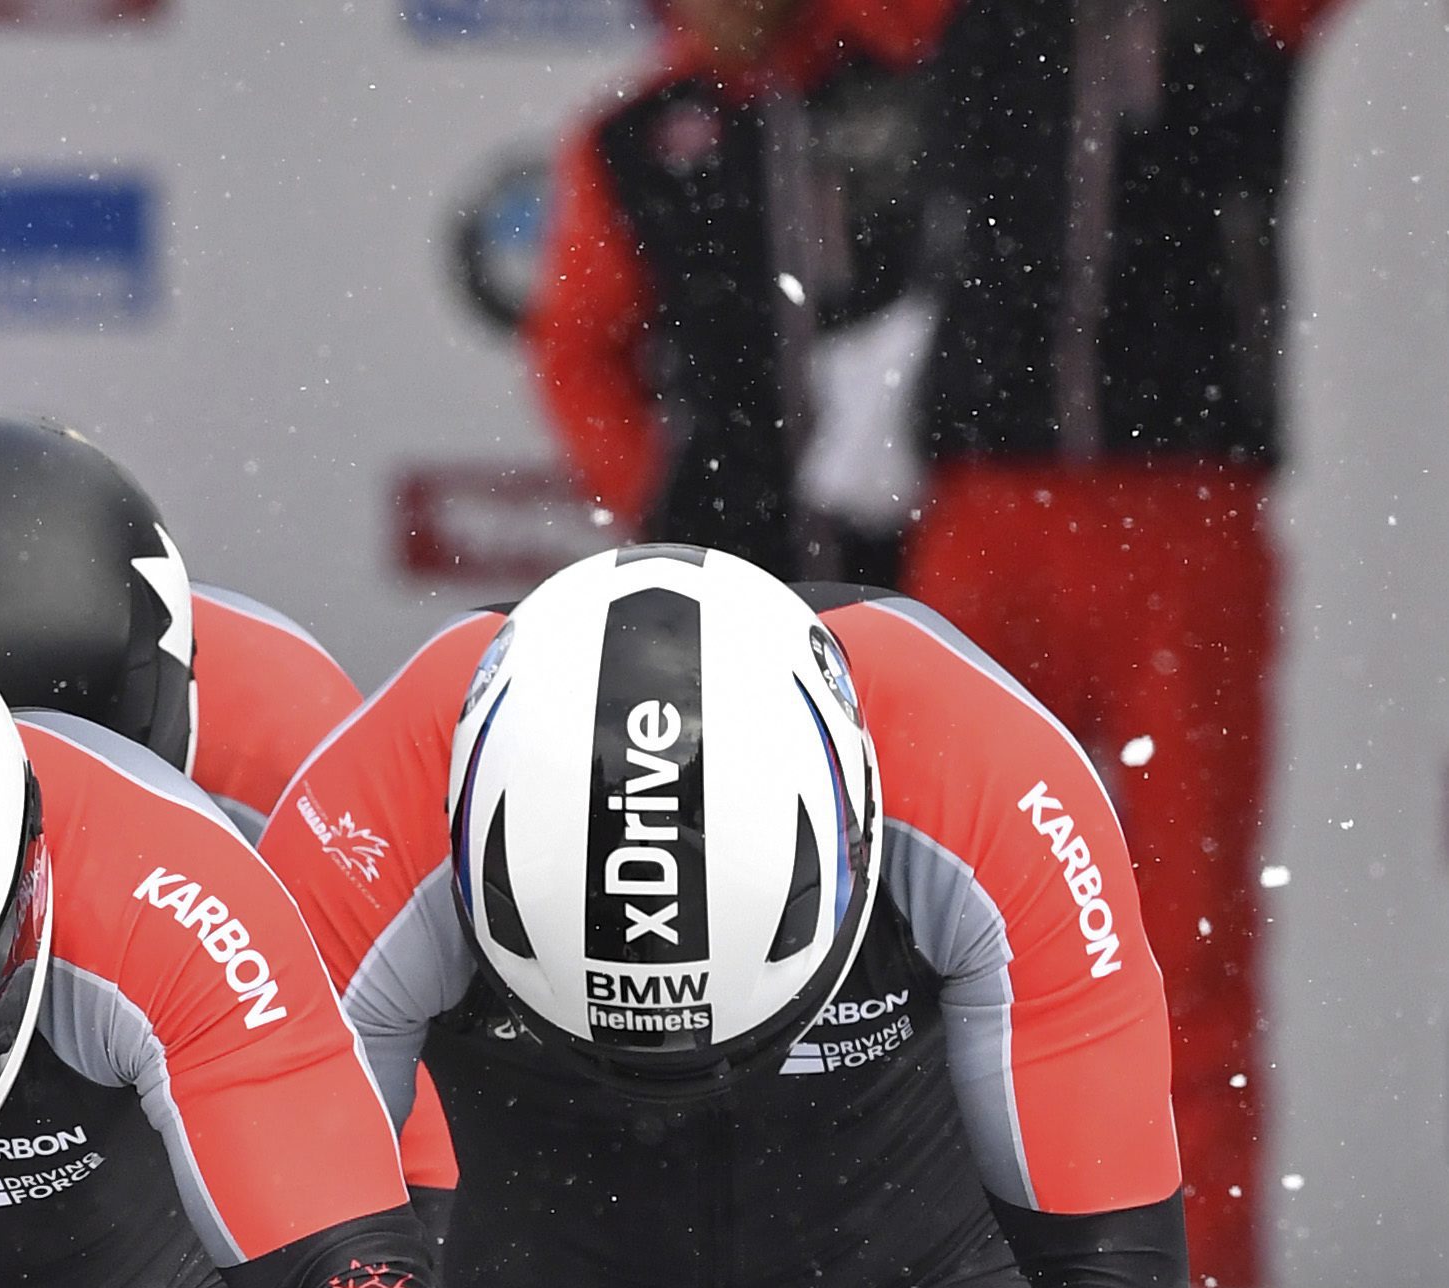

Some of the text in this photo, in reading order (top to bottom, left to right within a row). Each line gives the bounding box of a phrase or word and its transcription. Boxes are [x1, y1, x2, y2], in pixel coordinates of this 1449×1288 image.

[604, 699, 682, 946] xDrive
[1017, 780, 1122, 979] KARBON
[132, 866, 288, 1030] KARBON
[586, 969, 710, 1005] BMW
[815, 989, 909, 1026] RBON
[590, 1005, 710, 1032] helmets
[823, 1014, 910, 1056] DRIVING
[826, 1024, 915, 1072] FORCE
